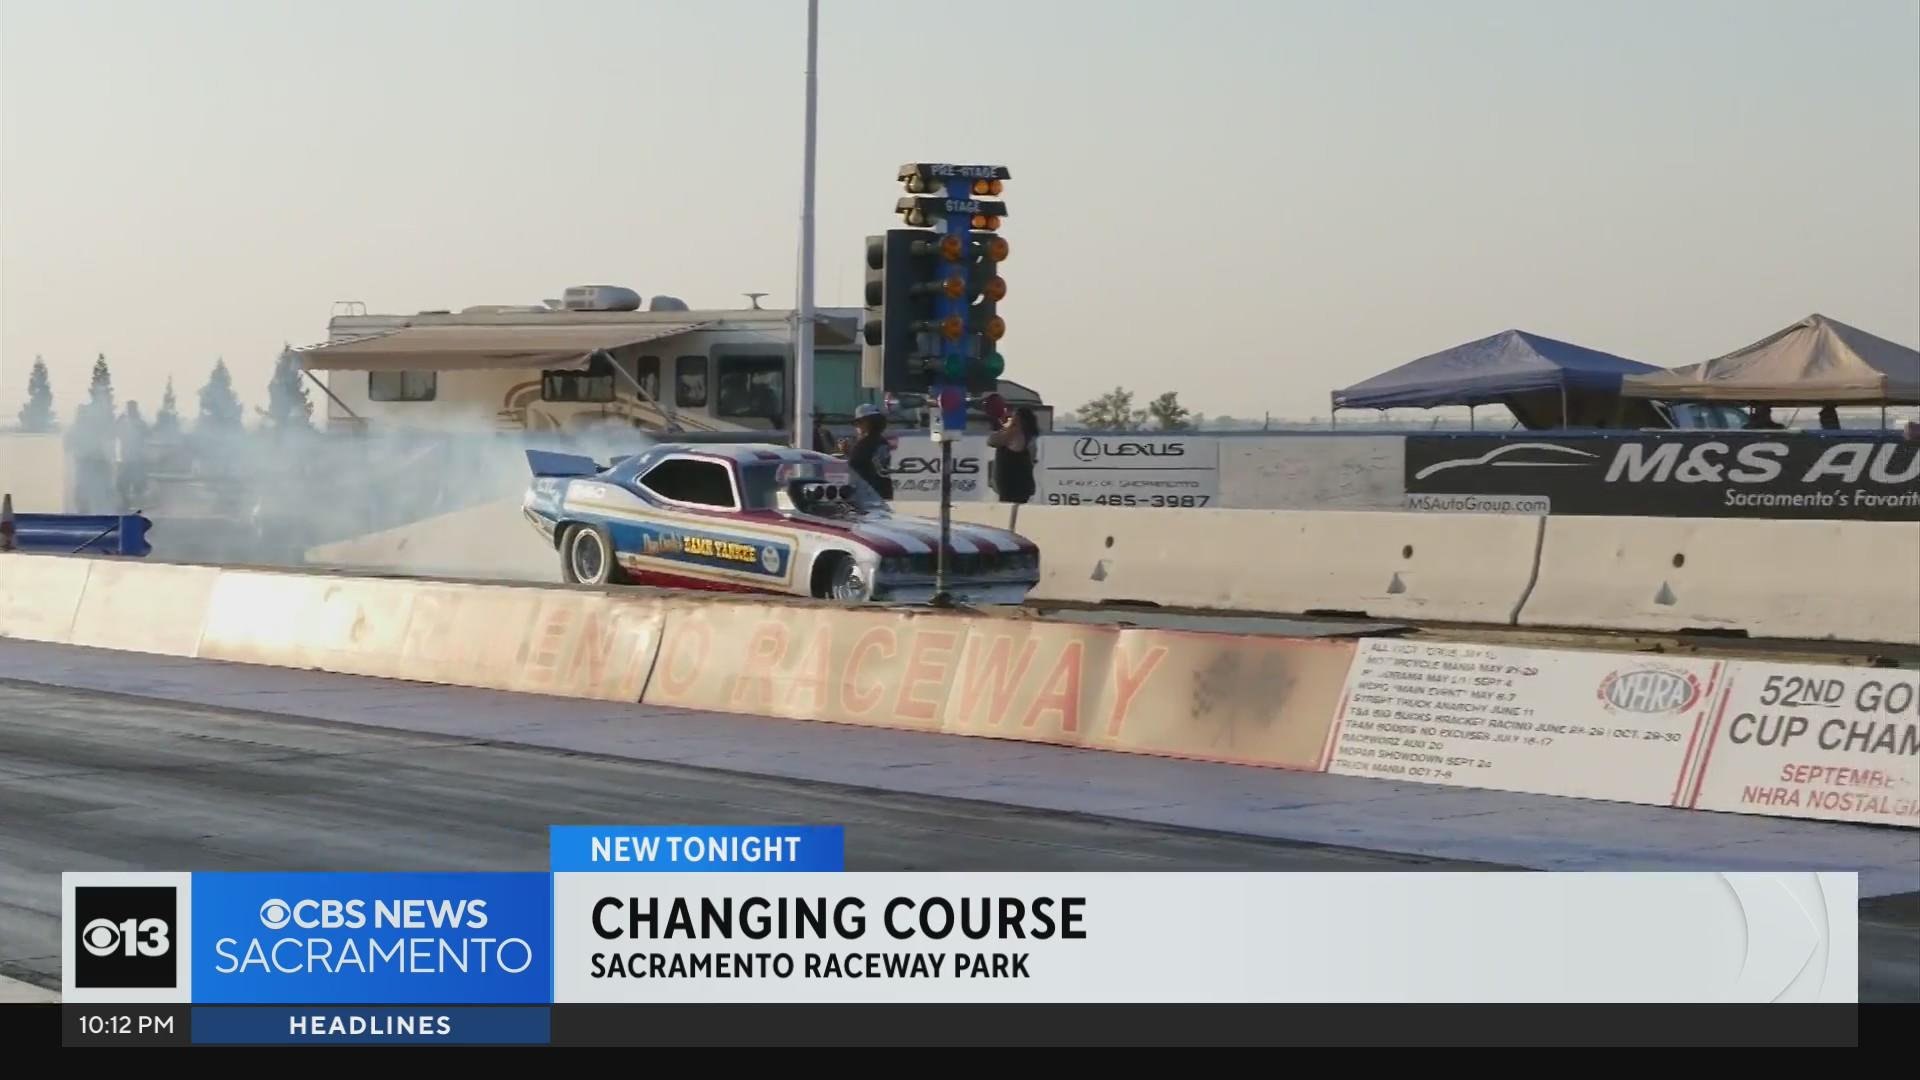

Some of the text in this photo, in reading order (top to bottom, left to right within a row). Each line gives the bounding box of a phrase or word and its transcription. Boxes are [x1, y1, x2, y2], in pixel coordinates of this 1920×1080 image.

[931, 165, 998, 178] PRE-STAGE
[945, 200, 981, 212] STAGE
[1103, 443, 1185, 456] LEXUS
[1604, 442, 1790, 483] M&S
[1408, 496, 1547, 514] MSAutoGroup.com
[1724, 488, 1920, 507] Sacramento's Favorit
[732, 620, 1169, 737] RACEWAY
[1610, 673, 1685, 711] NHRA
[1760, 675, 1920, 715] 52ND GO
[1729, 713, 1809, 747] CUP
[1742, 785, 1800, 807] NHRA
